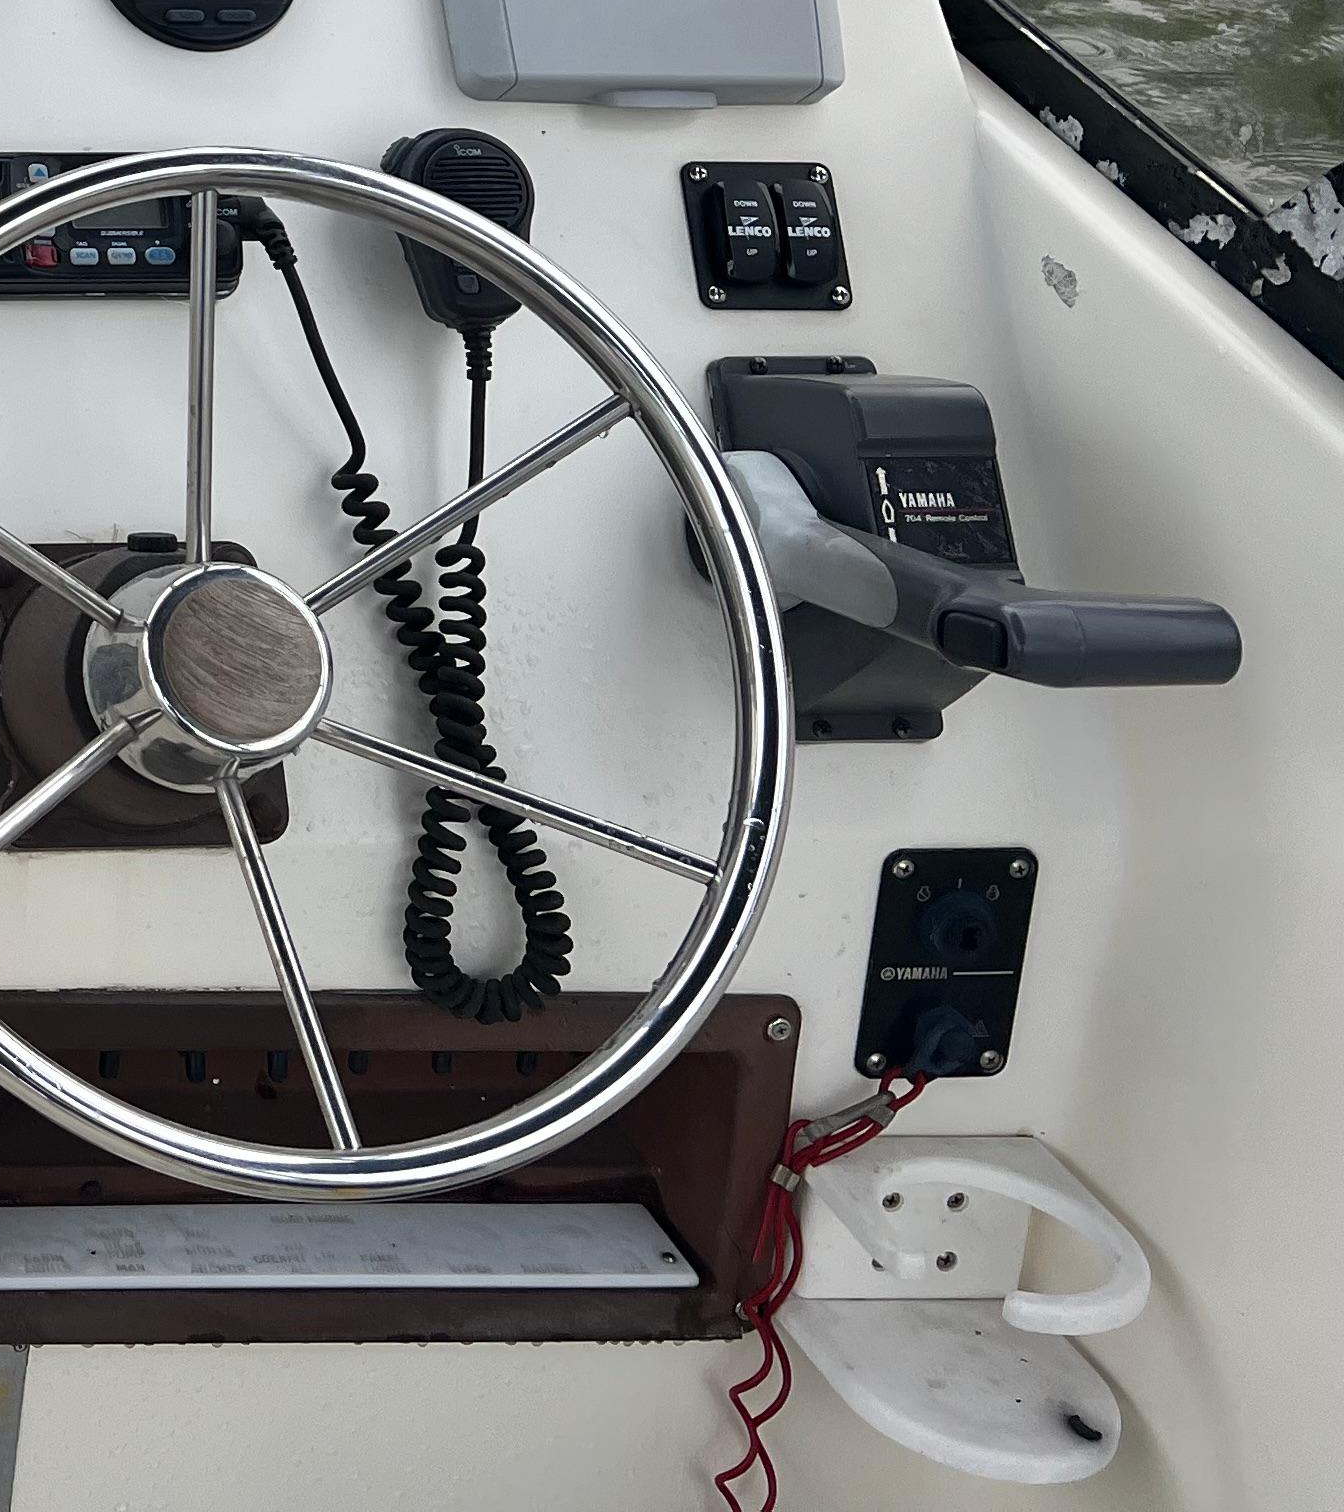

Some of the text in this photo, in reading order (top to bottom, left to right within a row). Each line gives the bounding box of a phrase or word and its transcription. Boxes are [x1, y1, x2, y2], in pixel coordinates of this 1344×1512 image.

[216, 208, 238, 216] COM
[727, 225, 772, 237] LENCO
[787, 226, 831, 238] LENCO
[746, 248, 758, 256] UP
[806, 248, 818, 256] UP
[898, 492, 956, 508] YAMAHA
[896, 967, 948, 980] YAMAHA
